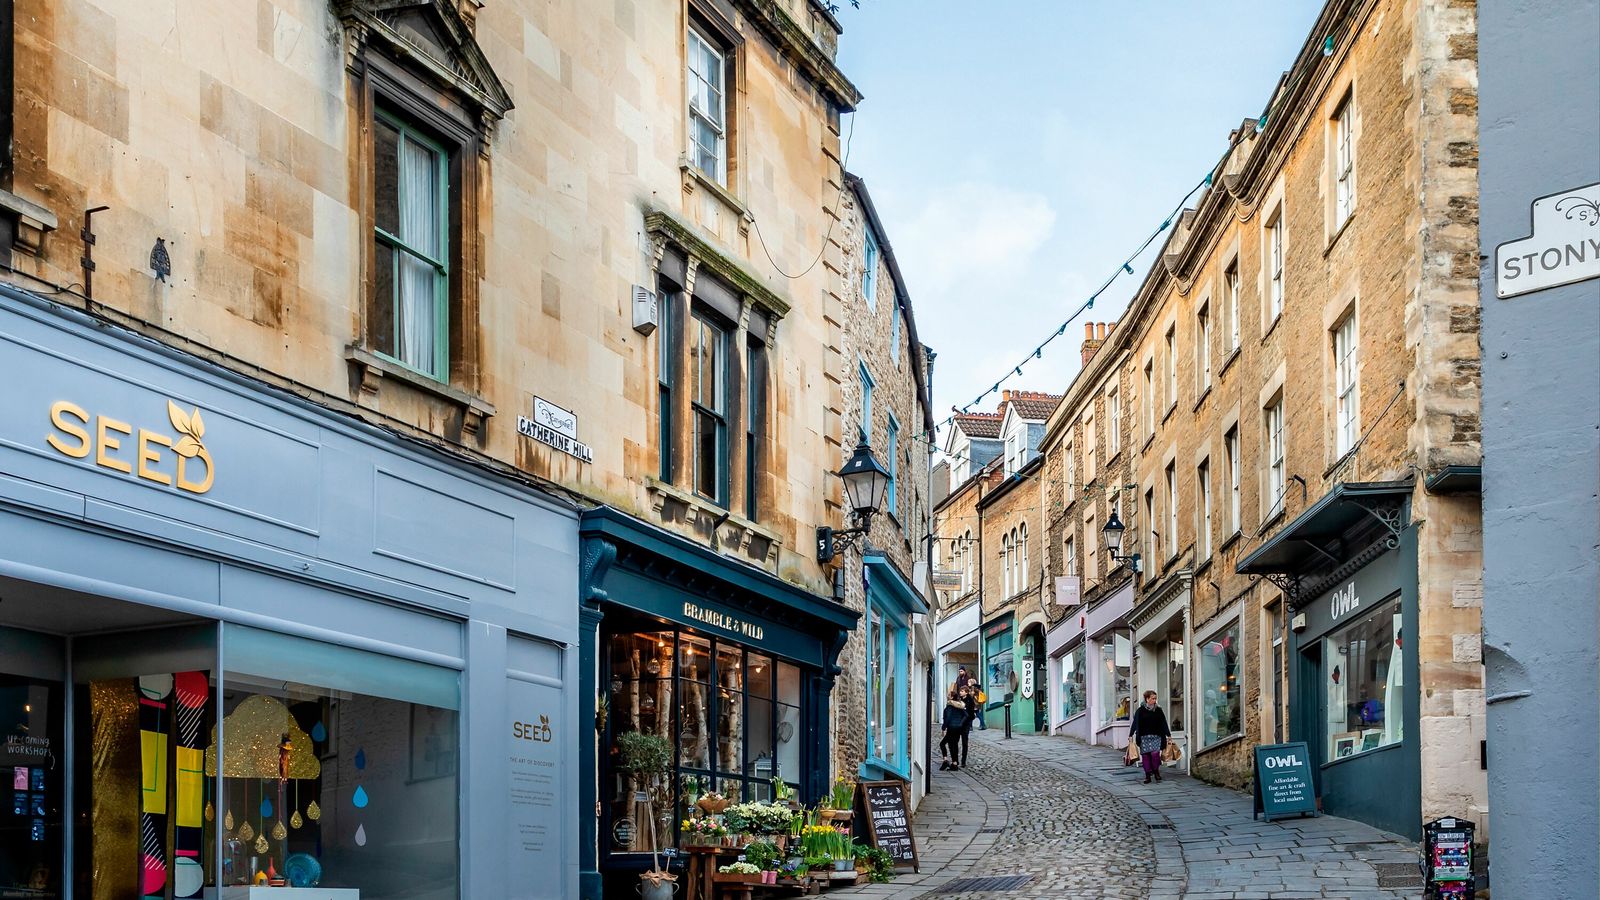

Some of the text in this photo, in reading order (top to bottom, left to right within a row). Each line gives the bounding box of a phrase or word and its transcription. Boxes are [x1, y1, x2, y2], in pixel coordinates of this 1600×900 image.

[1503, 238, 1600, 280] STONY
[46, 400, 215, 494] SEED
[519, 418, 570, 452] CATHERINE
[573, 442, 592, 462] HILL
[819, 539, 826, 550] 5
[1330, 581, 1360, 621] OWL
[683, 602, 764, 640] BRAMBLE & WILD
[1024, 662, 1032, 693] OPEN
[513, 714, 552, 743] SEED
[1265, 754, 1303, 769] OWL
